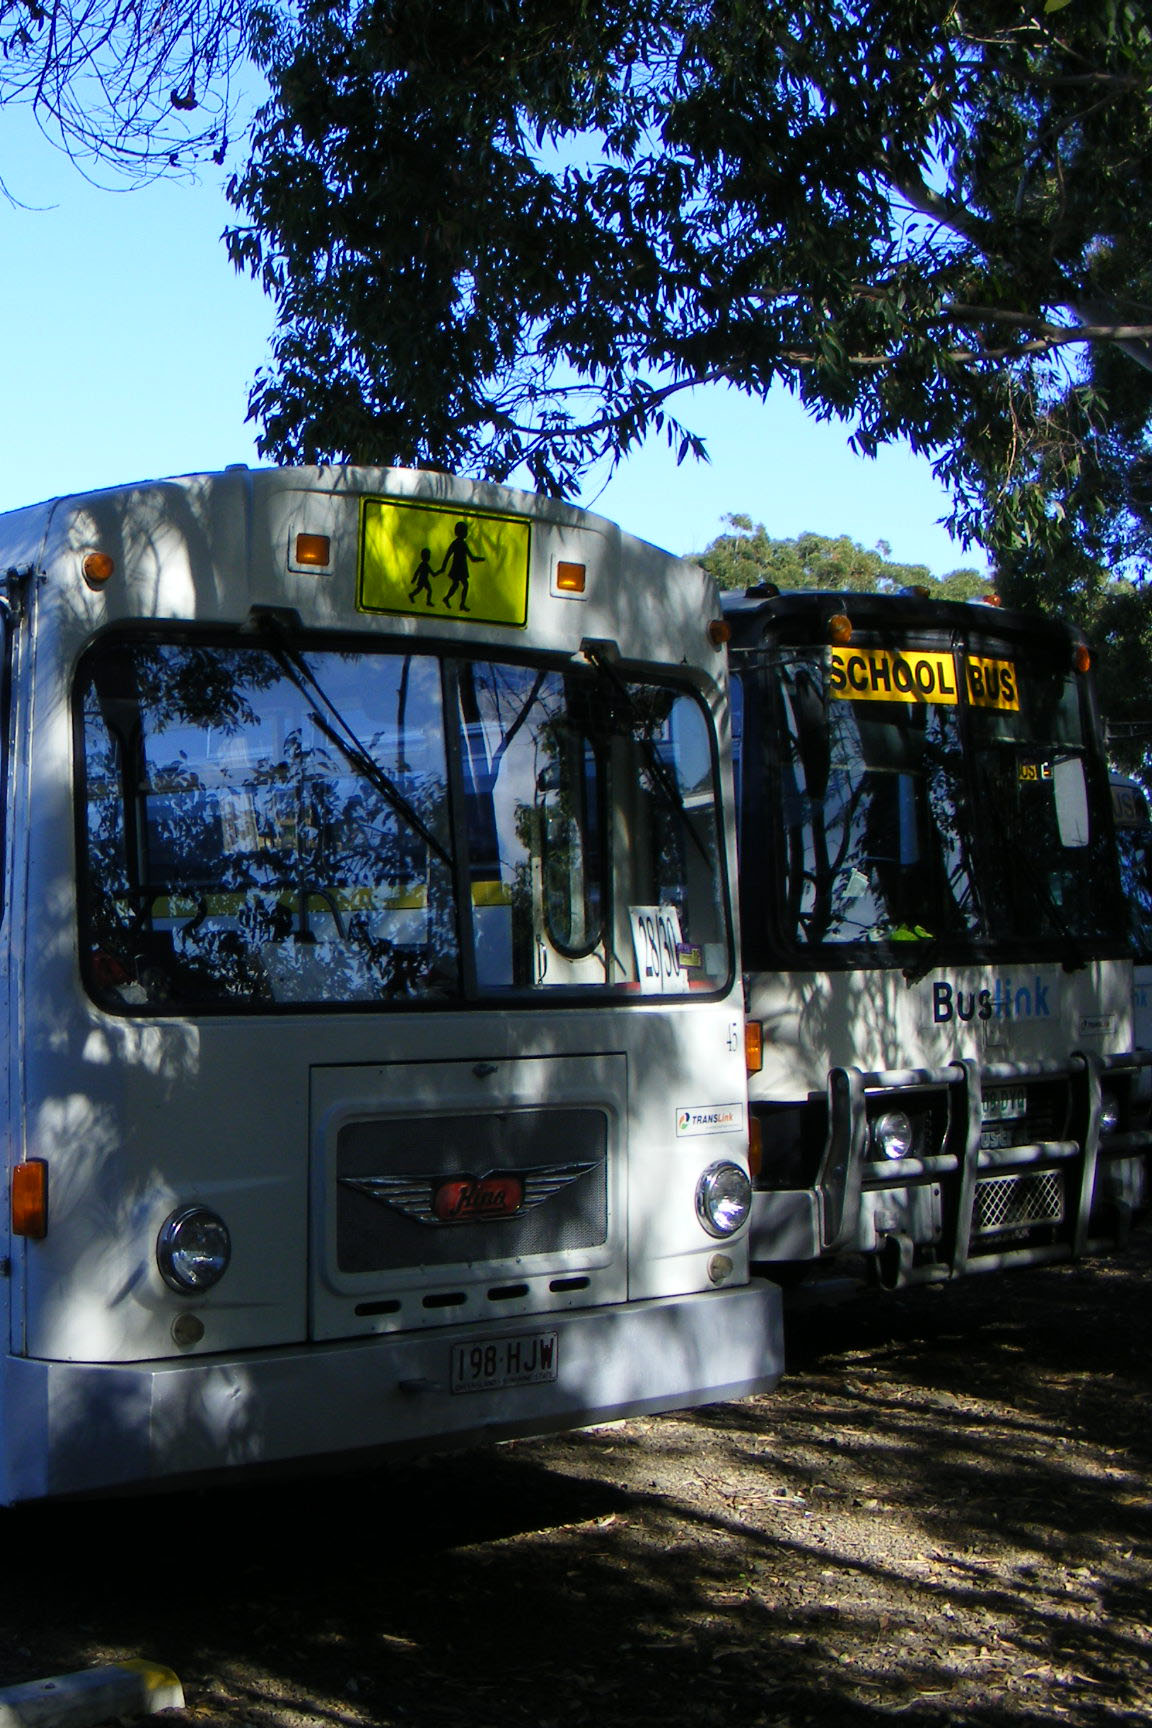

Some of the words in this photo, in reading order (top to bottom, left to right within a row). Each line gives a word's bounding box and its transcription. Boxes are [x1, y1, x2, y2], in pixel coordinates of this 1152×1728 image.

[831, 654, 955, 695] SCHOOL
[968, 664, 1015, 702] BUS
[933, 976, 1050, 1024] Buslink
